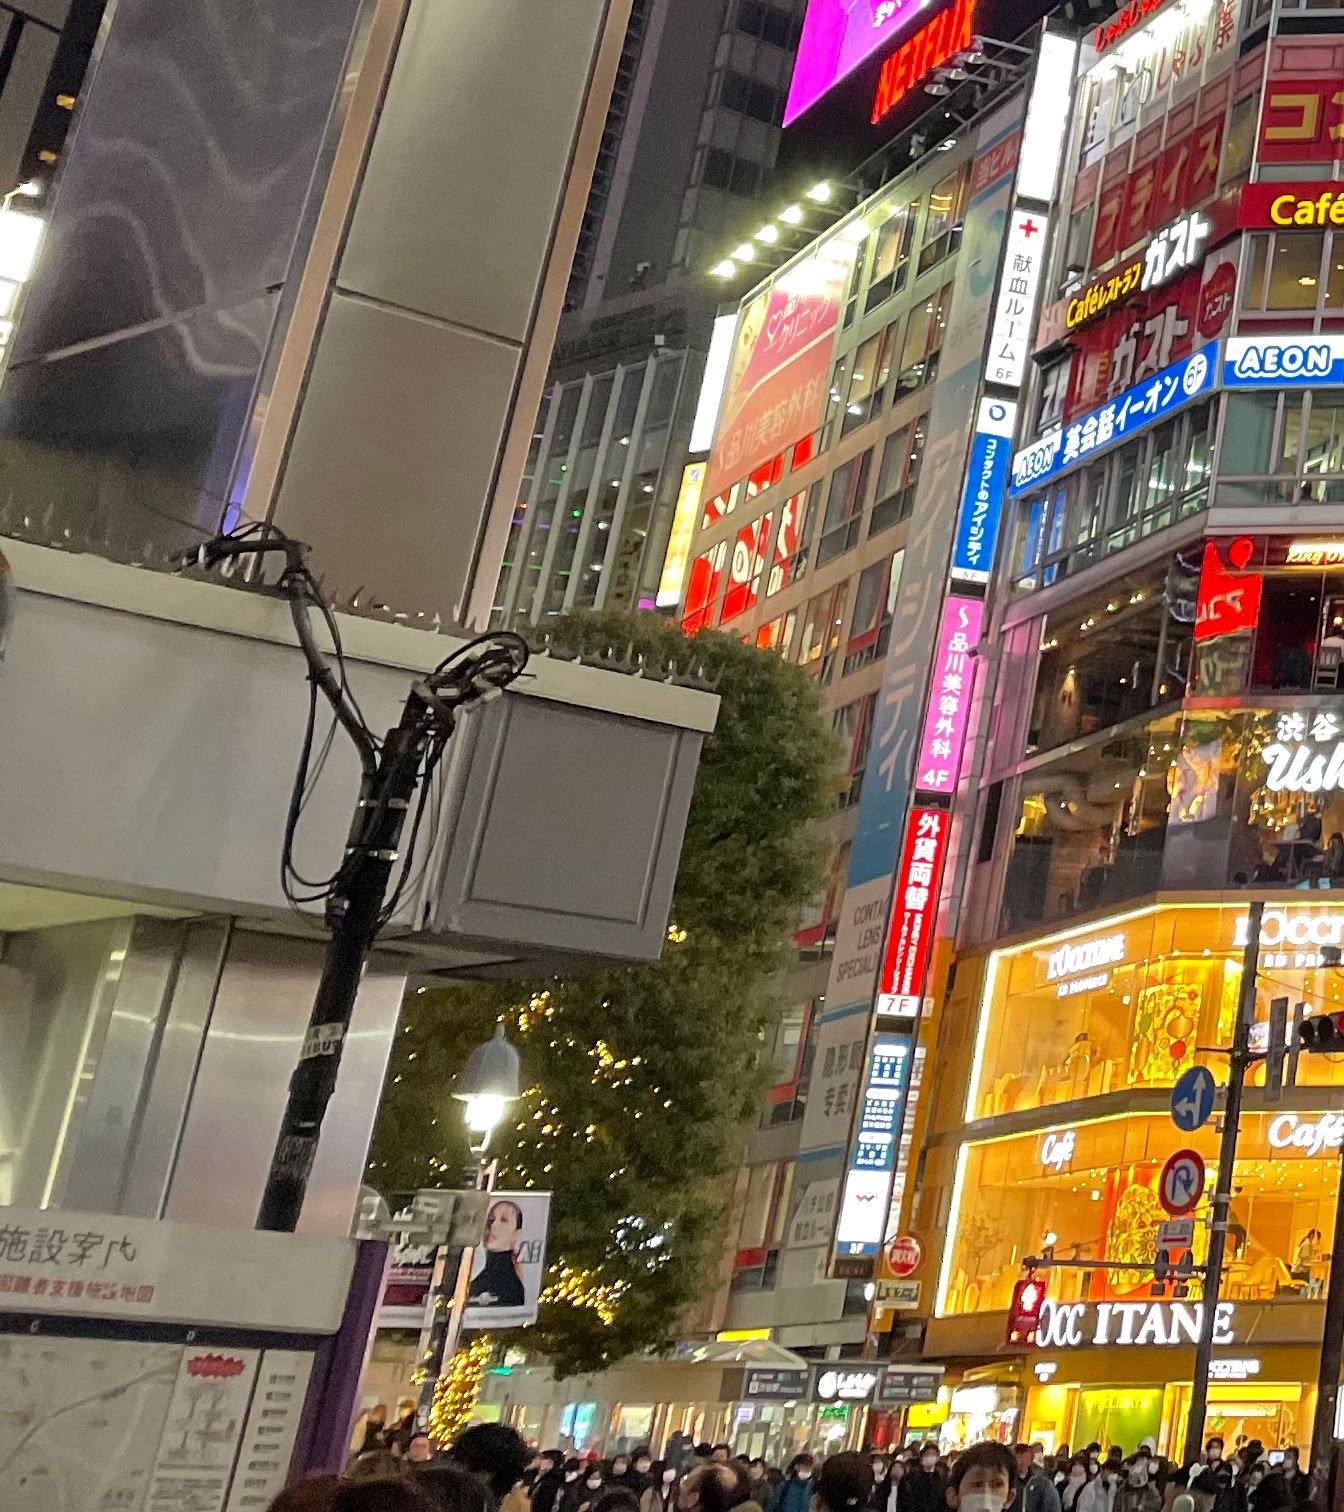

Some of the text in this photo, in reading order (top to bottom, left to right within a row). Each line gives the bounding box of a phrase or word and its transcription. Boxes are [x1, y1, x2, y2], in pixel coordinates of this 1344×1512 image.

[1141, 210, 1210, 290] ガスト
[997, 254, 1032, 363] 献血ルーム
[996, 366, 1014, 380] 6F
[1187, 359, 1206, 388] 6F
[1238, 344, 1334, 376] AEON
[1017, 375, 1179, 484] AEON 英会話イーオン
[930, 632, 969, 761] 品川美容外科
[922, 768, 949, 787] 4F
[904, 812, 942, 912] 外貨両替
[886, 997, 910, 1013] 7F
[1041, 1131, 1075, 1170] Café
